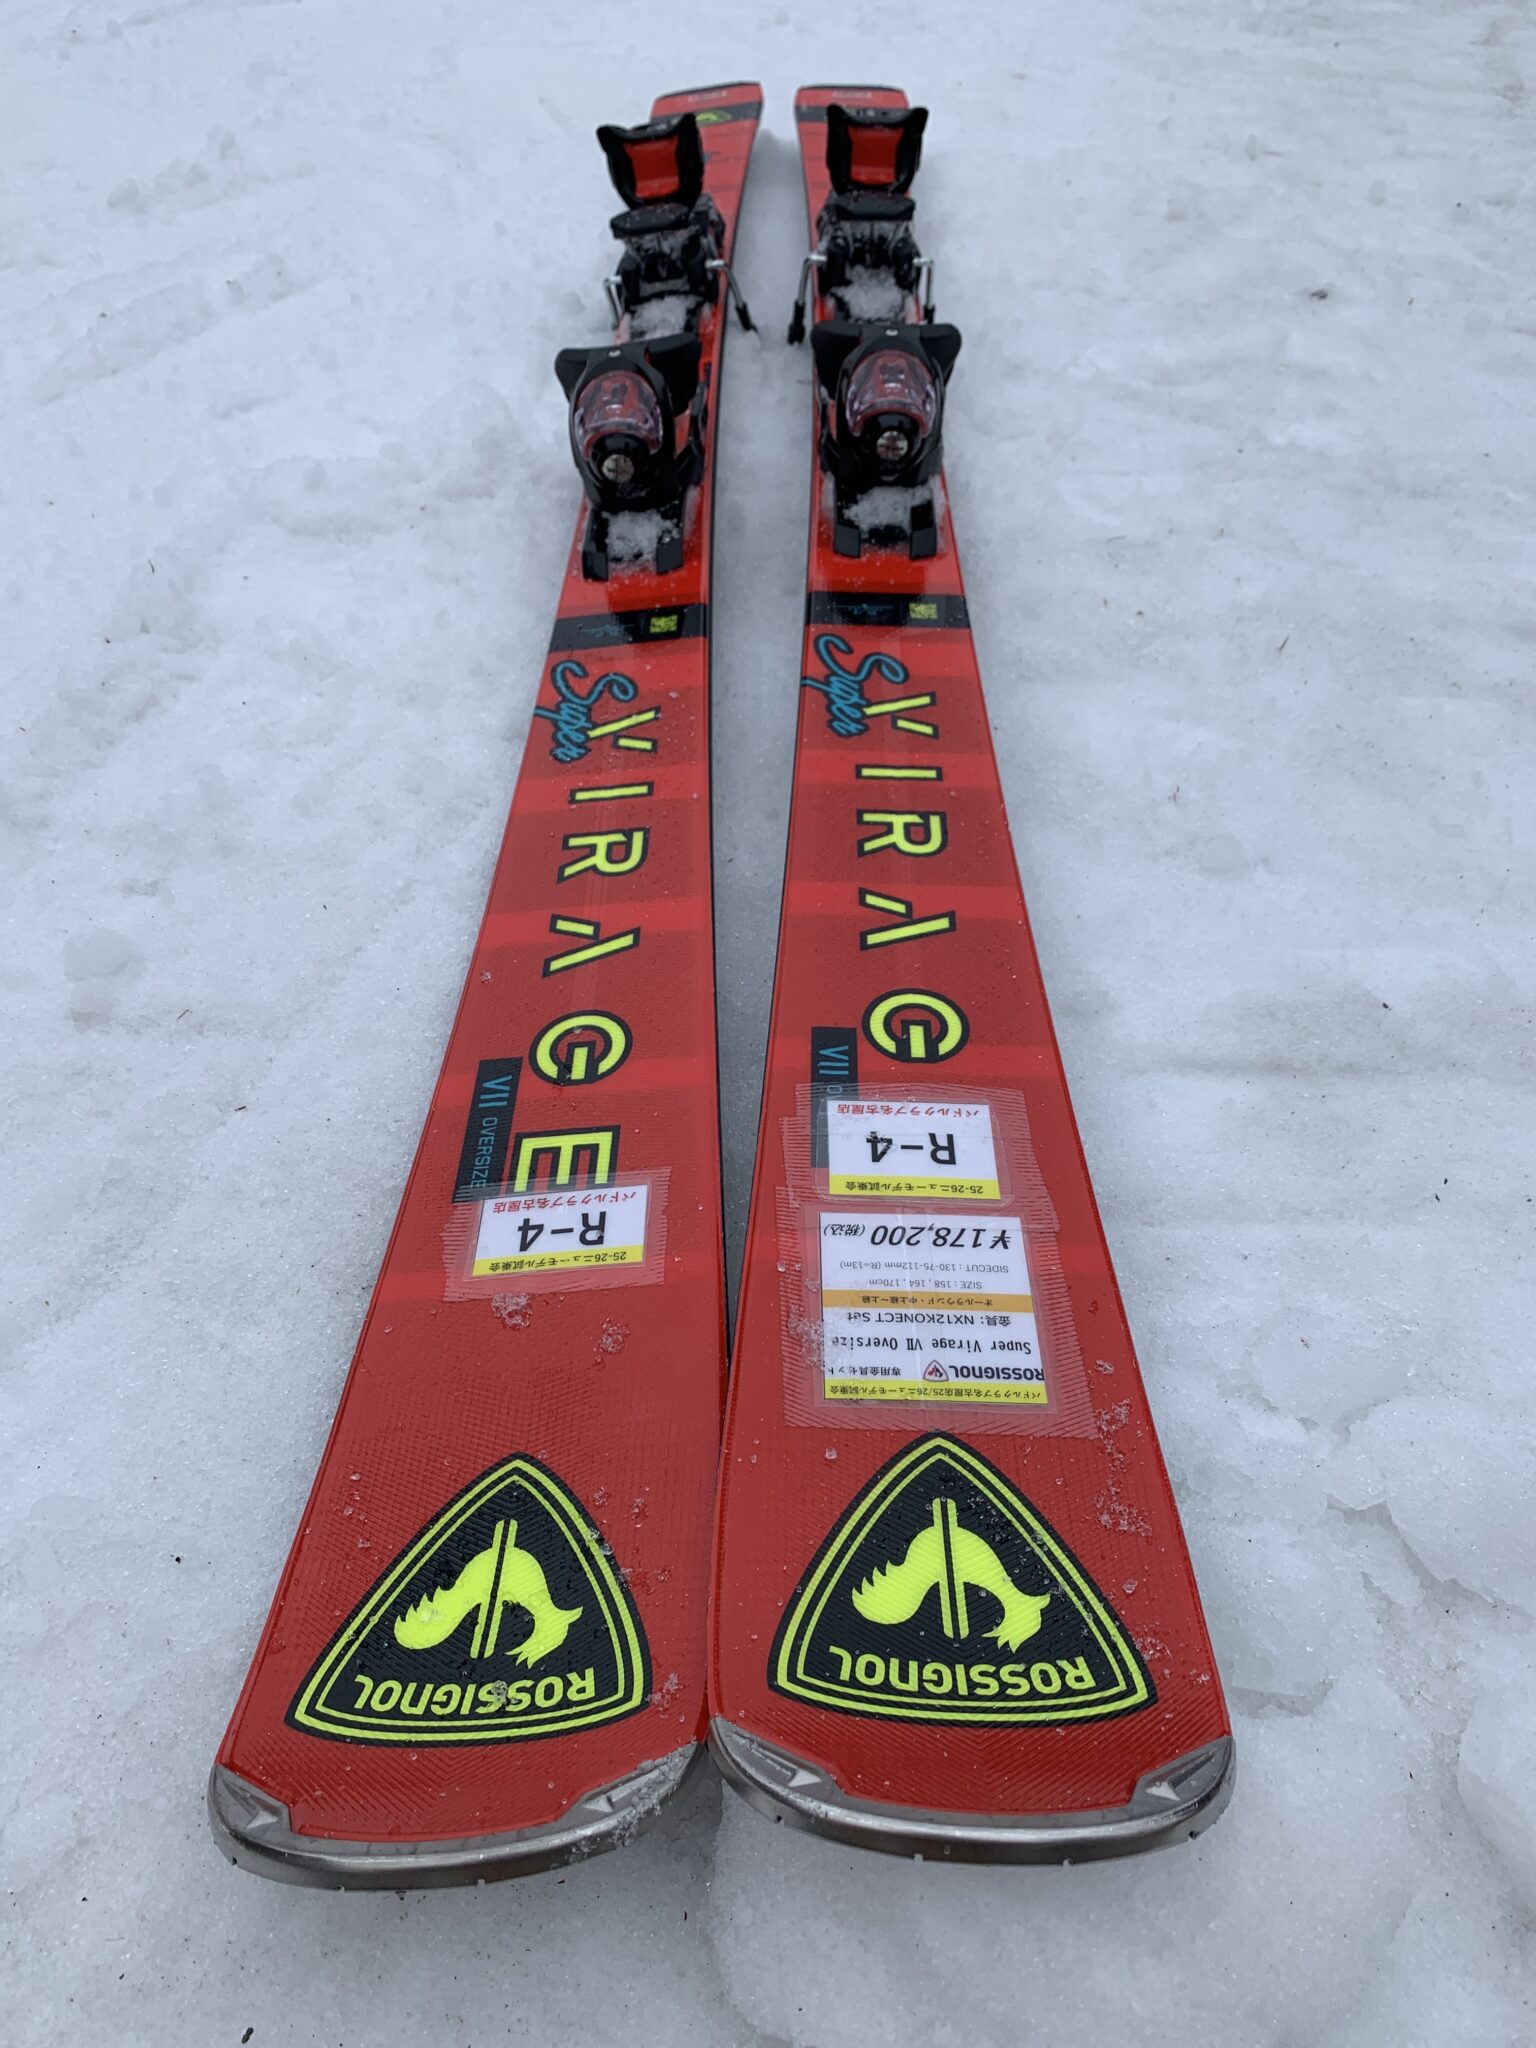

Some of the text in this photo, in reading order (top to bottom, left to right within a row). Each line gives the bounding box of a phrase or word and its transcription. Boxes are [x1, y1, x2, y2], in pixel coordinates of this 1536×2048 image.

[801, 633, 909, 736] Super
[535, 660, 637, 762] Super
[514, 708, 657, 1192] VIRAGE
[818, 1045, 849, 1075] VII
[470, 1074, 513, 1189] VII OVERSIZE
[866, 1131, 957, 1166] R-4
[845, 1181, 984, 1194] 25-26ニューモデル試乗会
[517, 1211, 607, 1252] R-4
[823, 1223, 866, 1237] (税込)
[489, 1251, 627, 1272] 25-26ニューモデル試乗会
[875, 1312, 974, 1325] NX12KONECT
[832, 1336, 898, 1350] Oversize
[932, 1338, 981, 1353] Virage
[991, 1340, 1032, 1354] Super
[828, 1366, 902, 1377] 専用金具セット
[948, 1365, 1045, 1381] ROSSIGNOL
[829, 1645, 1097, 1696] ROSSIGNOL
[354, 1667, 596, 1715] ROSSIGNOL
